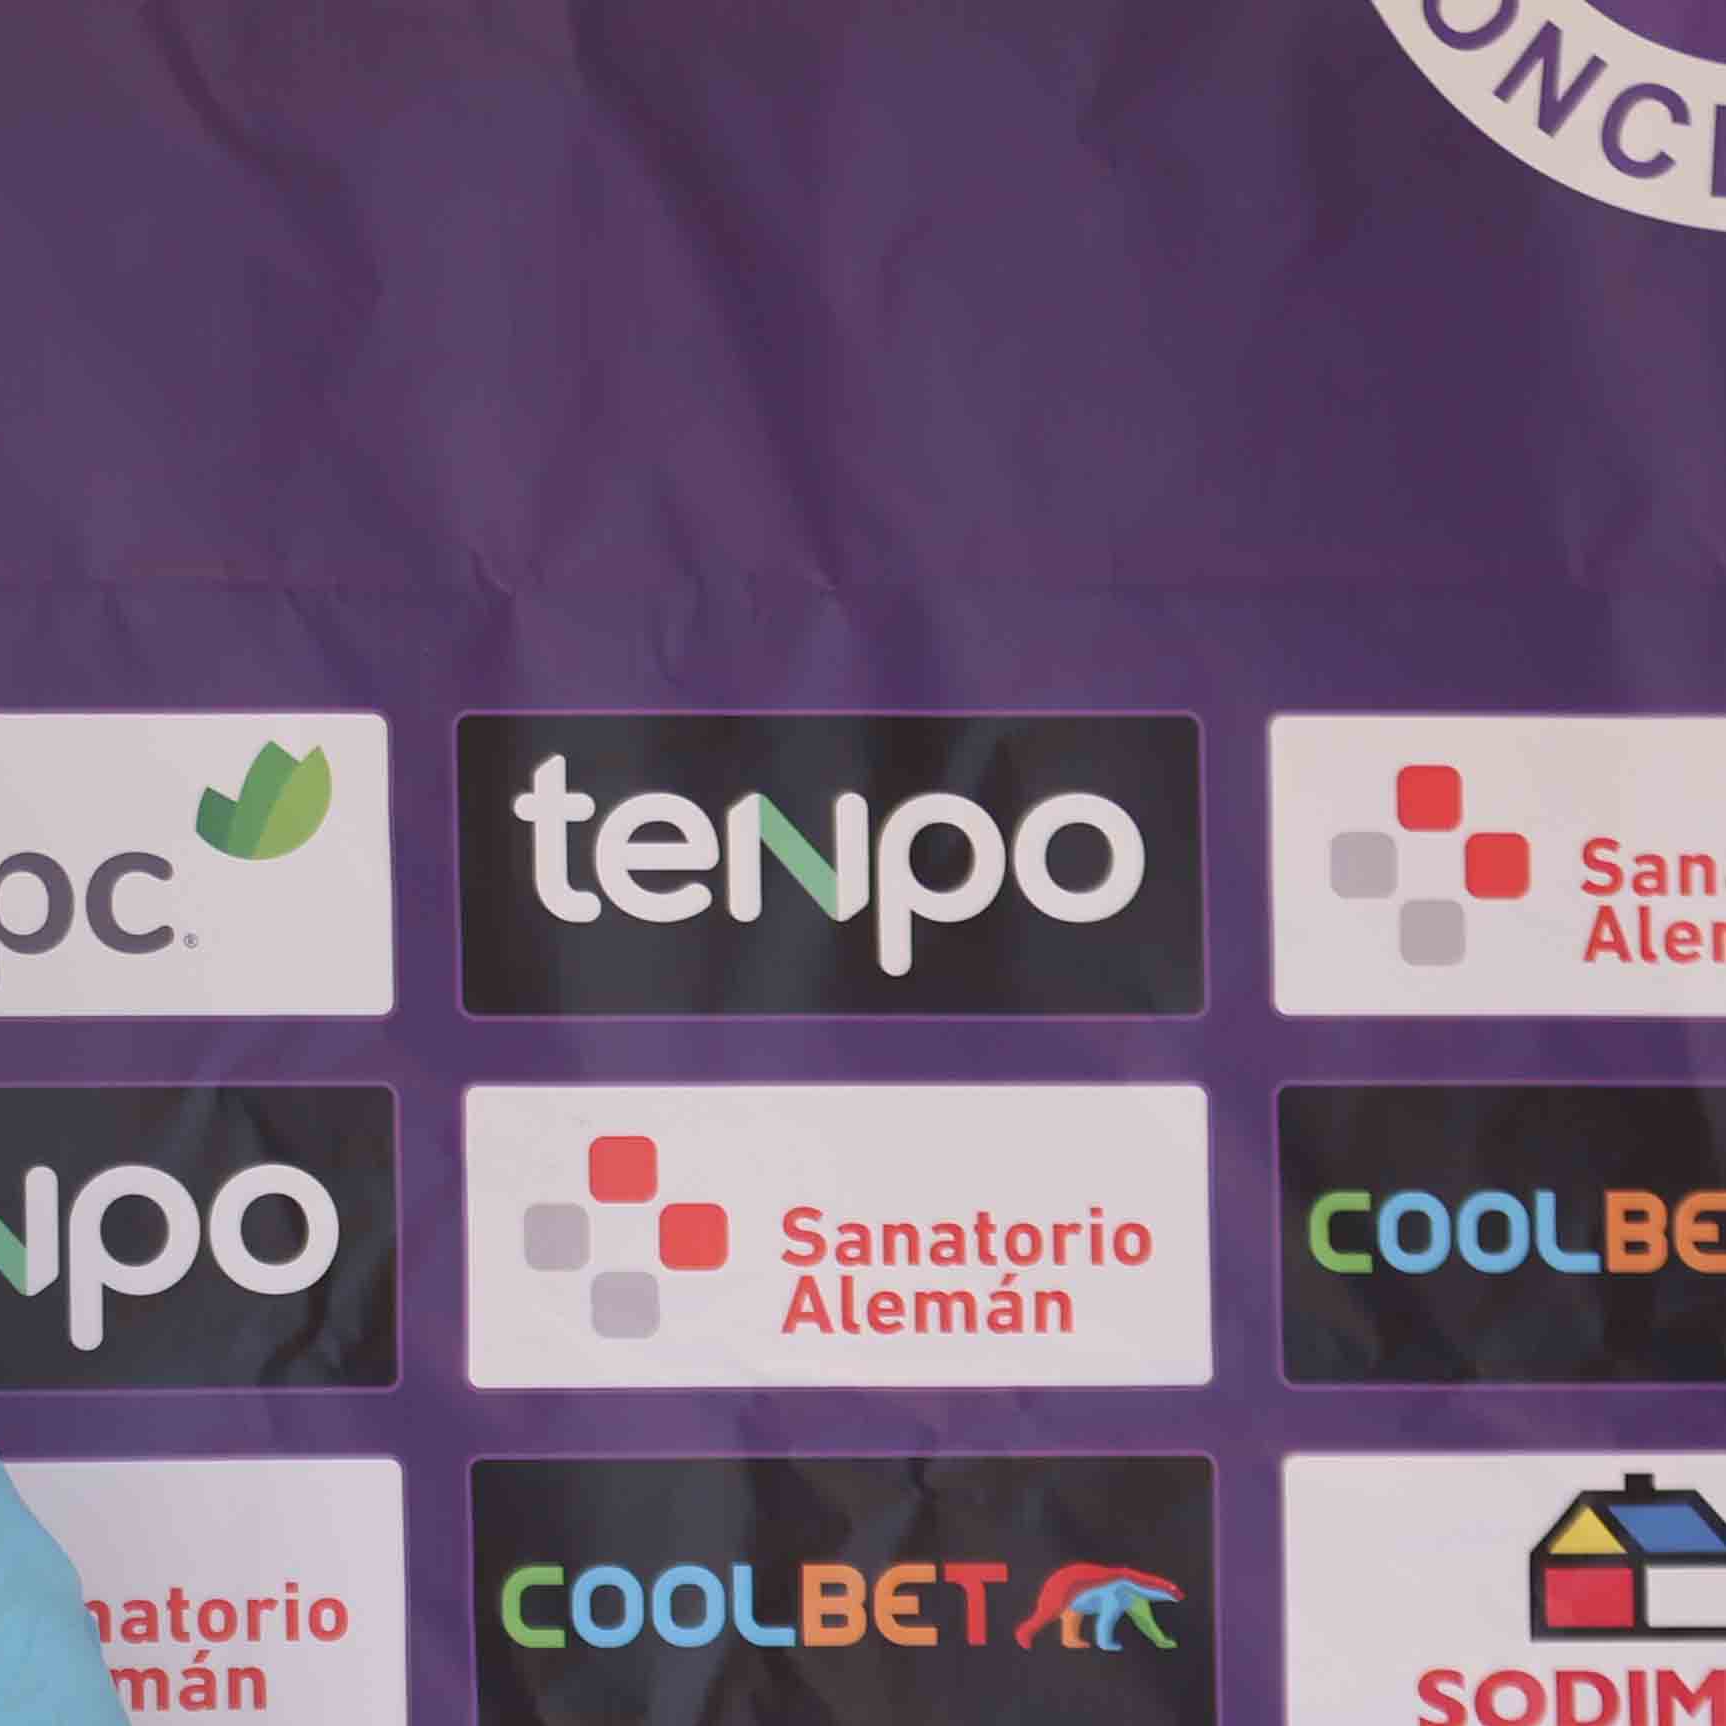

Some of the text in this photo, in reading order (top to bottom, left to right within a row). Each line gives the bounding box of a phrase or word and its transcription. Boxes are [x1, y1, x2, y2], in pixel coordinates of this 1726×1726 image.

[781, 1205, 1152, 1267] Sanatorio
[781, 1273, 1074, 1335] Alemán
[501, 1563, 1007, 1648] COOLBET
